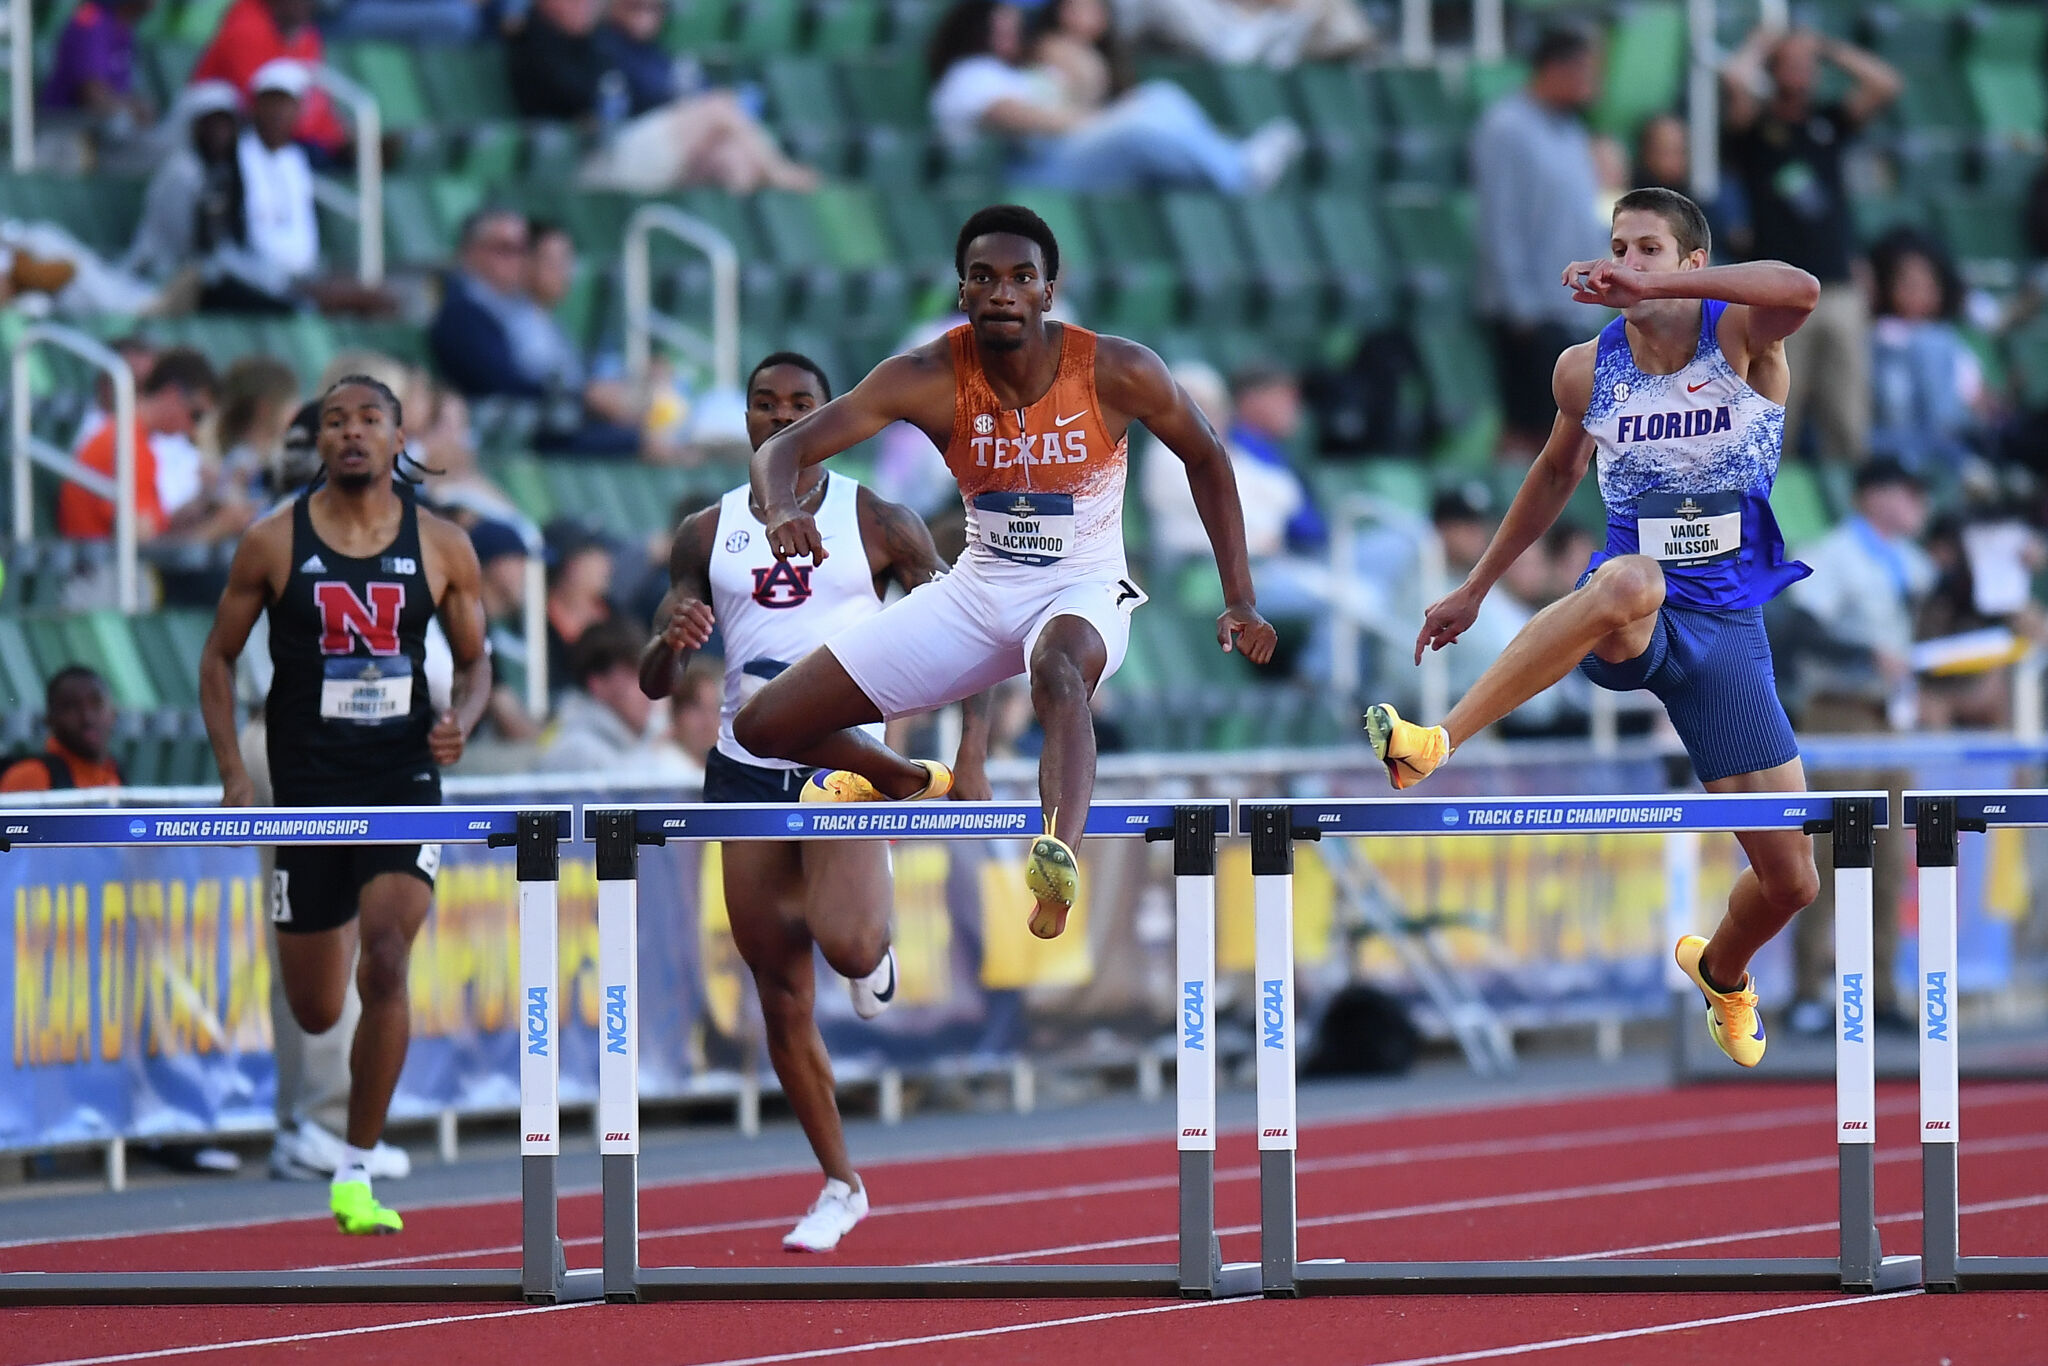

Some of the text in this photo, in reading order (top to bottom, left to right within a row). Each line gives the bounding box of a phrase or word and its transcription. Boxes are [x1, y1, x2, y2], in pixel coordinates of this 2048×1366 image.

[1614, 385, 1630, 401] SEC
[974, 415, 995, 433] SEC
[1617, 406, 1731, 443] FLORIDA
[970, 430, 1088, 469] TEXAS
[1008, 521, 1041, 534] KODY
[1671, 524, 1711, 538] VANCE
[990, 531, 1063, 552] BLACKWOOD
[1664, 539, 1719, 555] NILSSON
[1116, 579, 1140, 609] 7
[314, 581, 406, 656] N
[1468, 807, 1683, 825] TRACK & FIELD CHAMPIONSHIPS
[1783, 808, 1808, 817] GILL
[1982, 805, 2007, 814] GILL
[468, 821, 492, 830] GILL
[662, 819, 687, 828] GILL
[812, 813, 1027, 830] TRACK & FIELD CHAMPIONSHIPS
[1125, 815, 1150, 824] GILL
[1317, 814, 1342, 822] GILL
[5, 825, 30, 834] GILL
[155, 819, 369, 836] TRACK & FIELD CHAMPIONSHIPS
[1264, 980, 1284, 1050] NCAA
[1844, 973, 1864, 1044] NCAA
[1927, 972, 1948, 1042] NCAA
[528, 987, 548, 1057] NCAA
[607, 985, 627, 1055] NCAA
[1184, 981, 1205, 1051] NCAA
[1183, 1128, 1208, 1137] GILL
[1263, 1128, 1288, 1137] GILL
[1843, 1121, 1868, 1130] GILL
[1926, 1121, 1951, 1130] GILL
[526, 1133, 551, 1142] GILL
[605, 1133, 630, 1141] GILL
